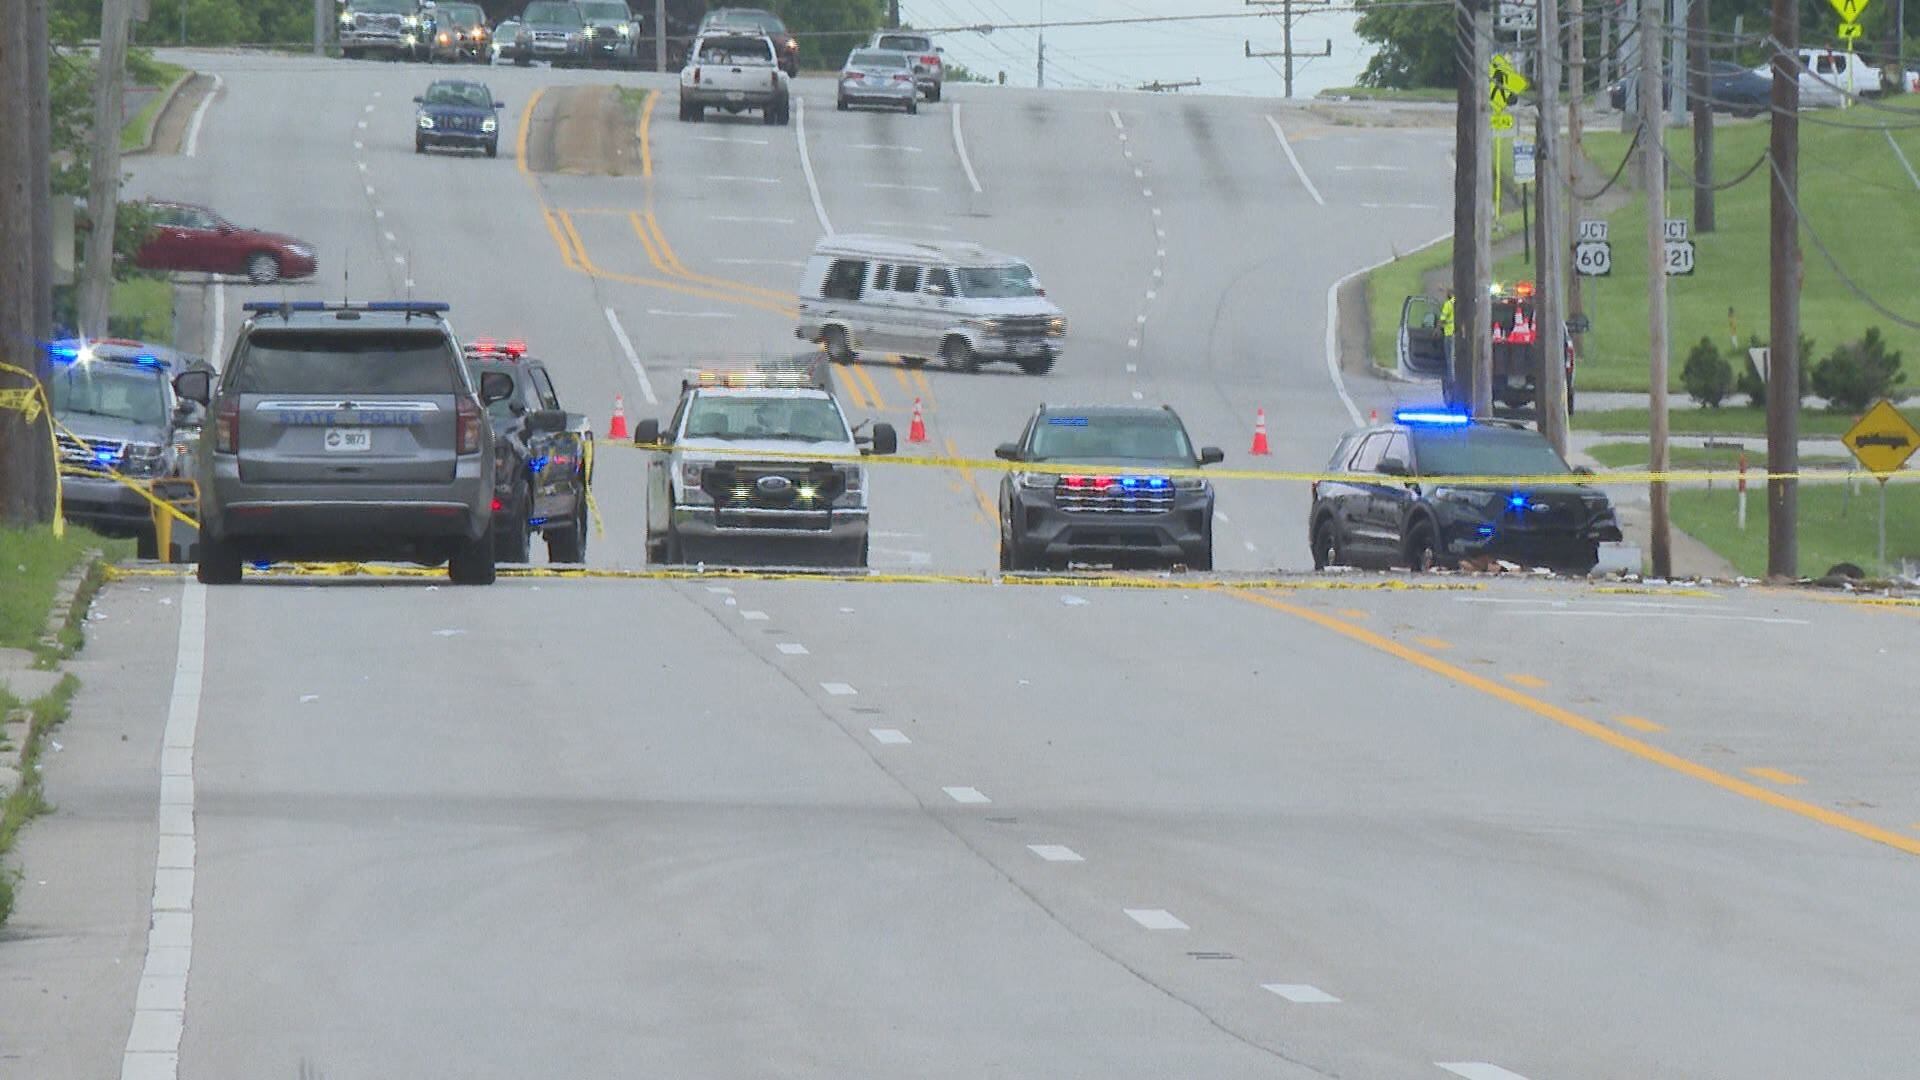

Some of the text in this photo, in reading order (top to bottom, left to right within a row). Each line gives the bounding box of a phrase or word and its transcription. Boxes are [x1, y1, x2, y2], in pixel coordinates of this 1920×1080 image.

[1581, 223, 1606, 238] JCT
[1581, 251, 1605, 266] 60
[1664, 250, 1689, 266] 21
[279, 411, 421, 424] STATE POLICE
